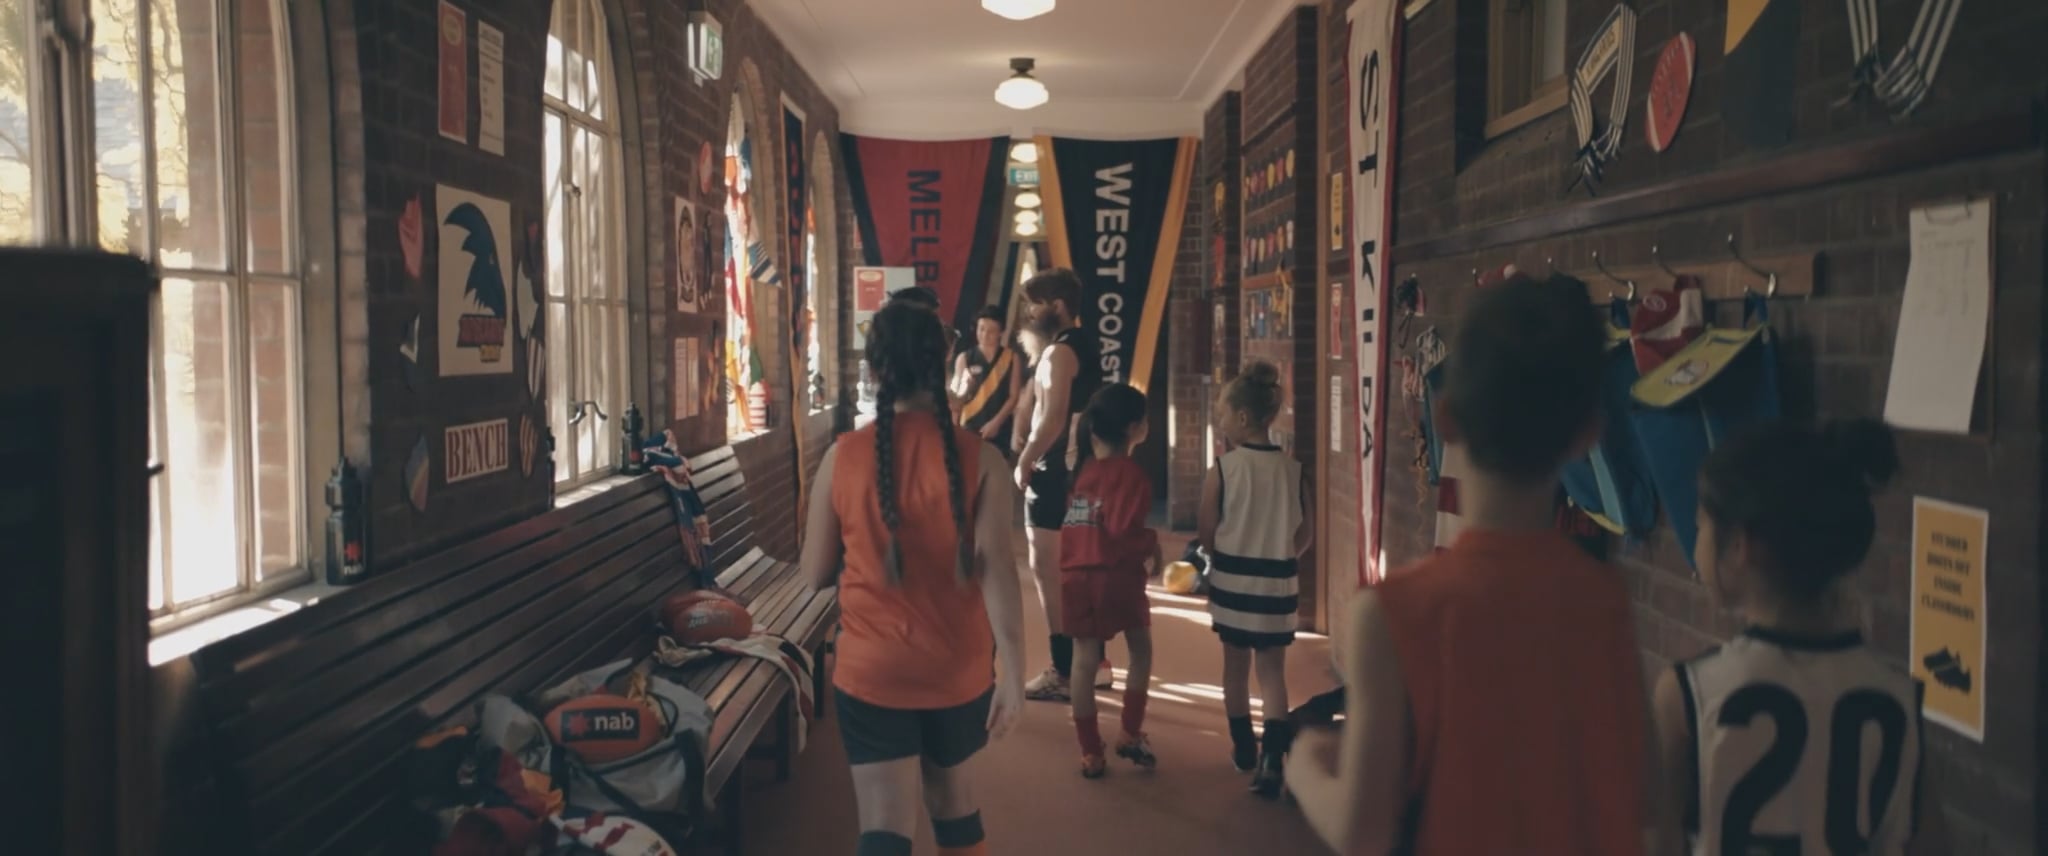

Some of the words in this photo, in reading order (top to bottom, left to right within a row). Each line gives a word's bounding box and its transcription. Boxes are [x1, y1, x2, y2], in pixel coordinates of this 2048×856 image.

[1359, 49, 1379, 188] ST
[907, 169, 941, 289] MELB
[1095, 162, 1133, 283] WEST
[1098, 292, 1123, 385] COAST
[1361, 239, 1375, 459] KILDA
[447, 424, 506, 479] BENCH
[594, 712, 635, 731] nab
[1717, 678, 1908, 856] 20
